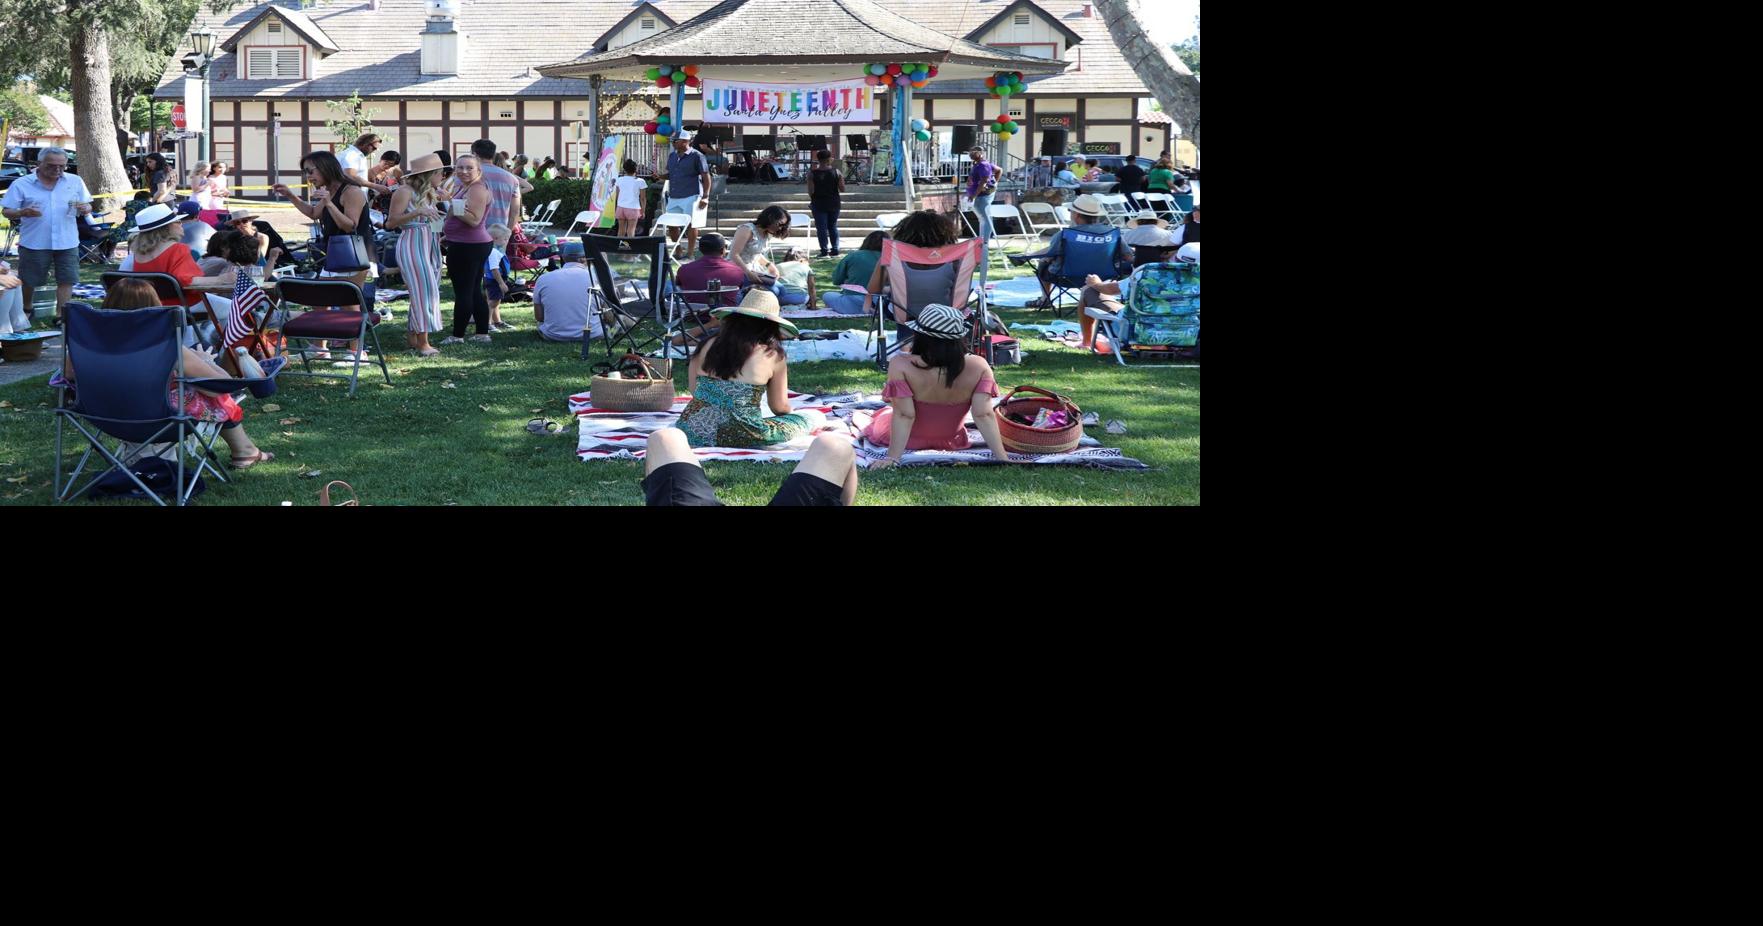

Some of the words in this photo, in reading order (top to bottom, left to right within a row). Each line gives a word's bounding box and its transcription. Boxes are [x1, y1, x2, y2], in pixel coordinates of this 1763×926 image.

[706, 86, 870, 113] JUNETEENTH
[173, 112, 185, 121] STO
[723, 103, 764, 117] Santa
[769, 105, 801, 120] Ynez
[807, 103, 853, 120] Valley
